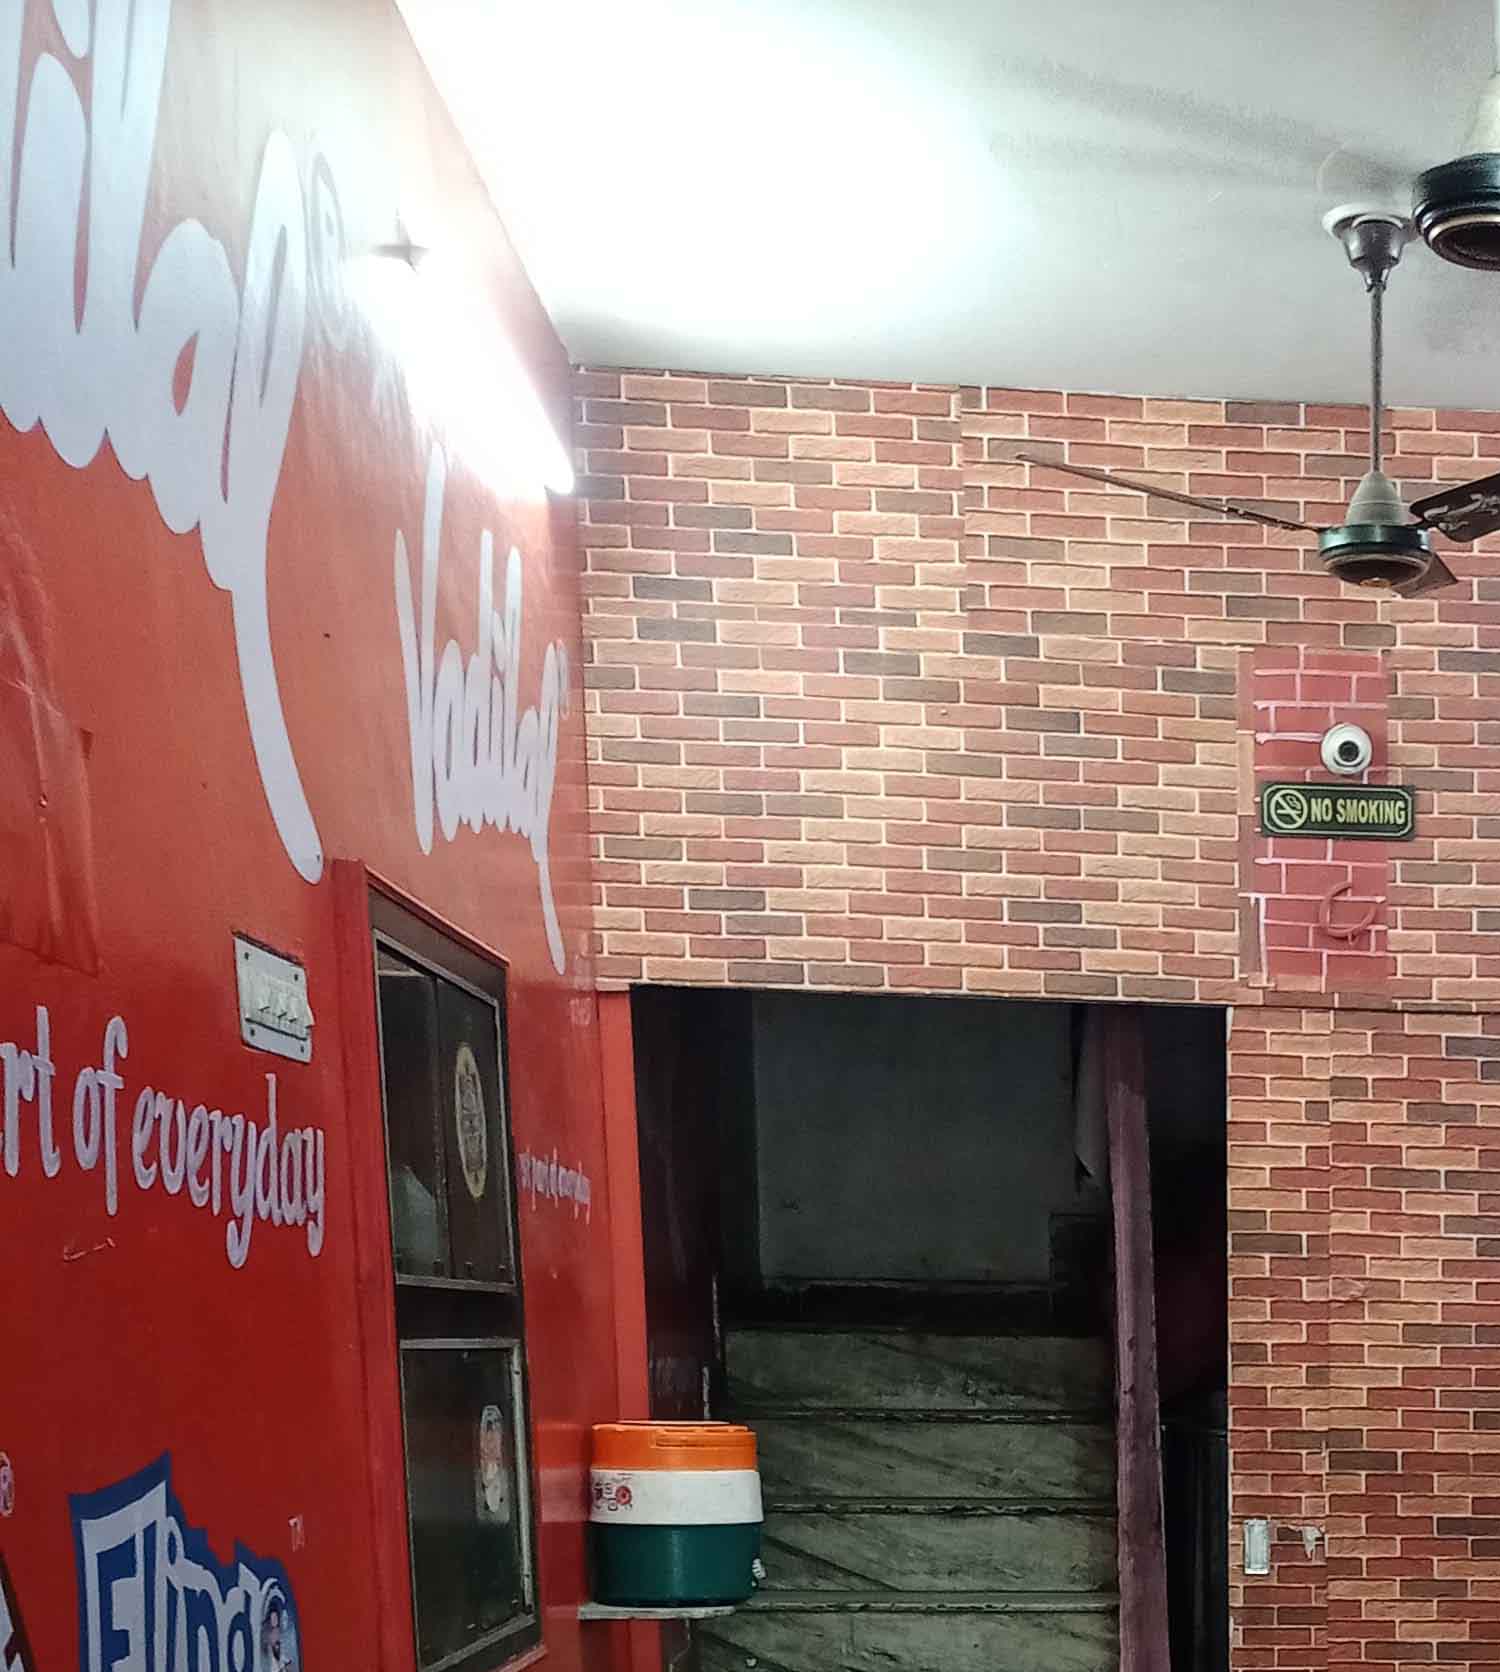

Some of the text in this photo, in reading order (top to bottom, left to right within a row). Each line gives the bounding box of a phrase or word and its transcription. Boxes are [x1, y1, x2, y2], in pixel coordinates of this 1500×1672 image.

[394, 440, 566, 975] Vadilal
[1310, 797, 1406, 825] NO SMOKING
[0, 1004, 61, 1178] rt
[73, 1016, 128, 1217] of
[132, 1073, 325, 1269] everyday
